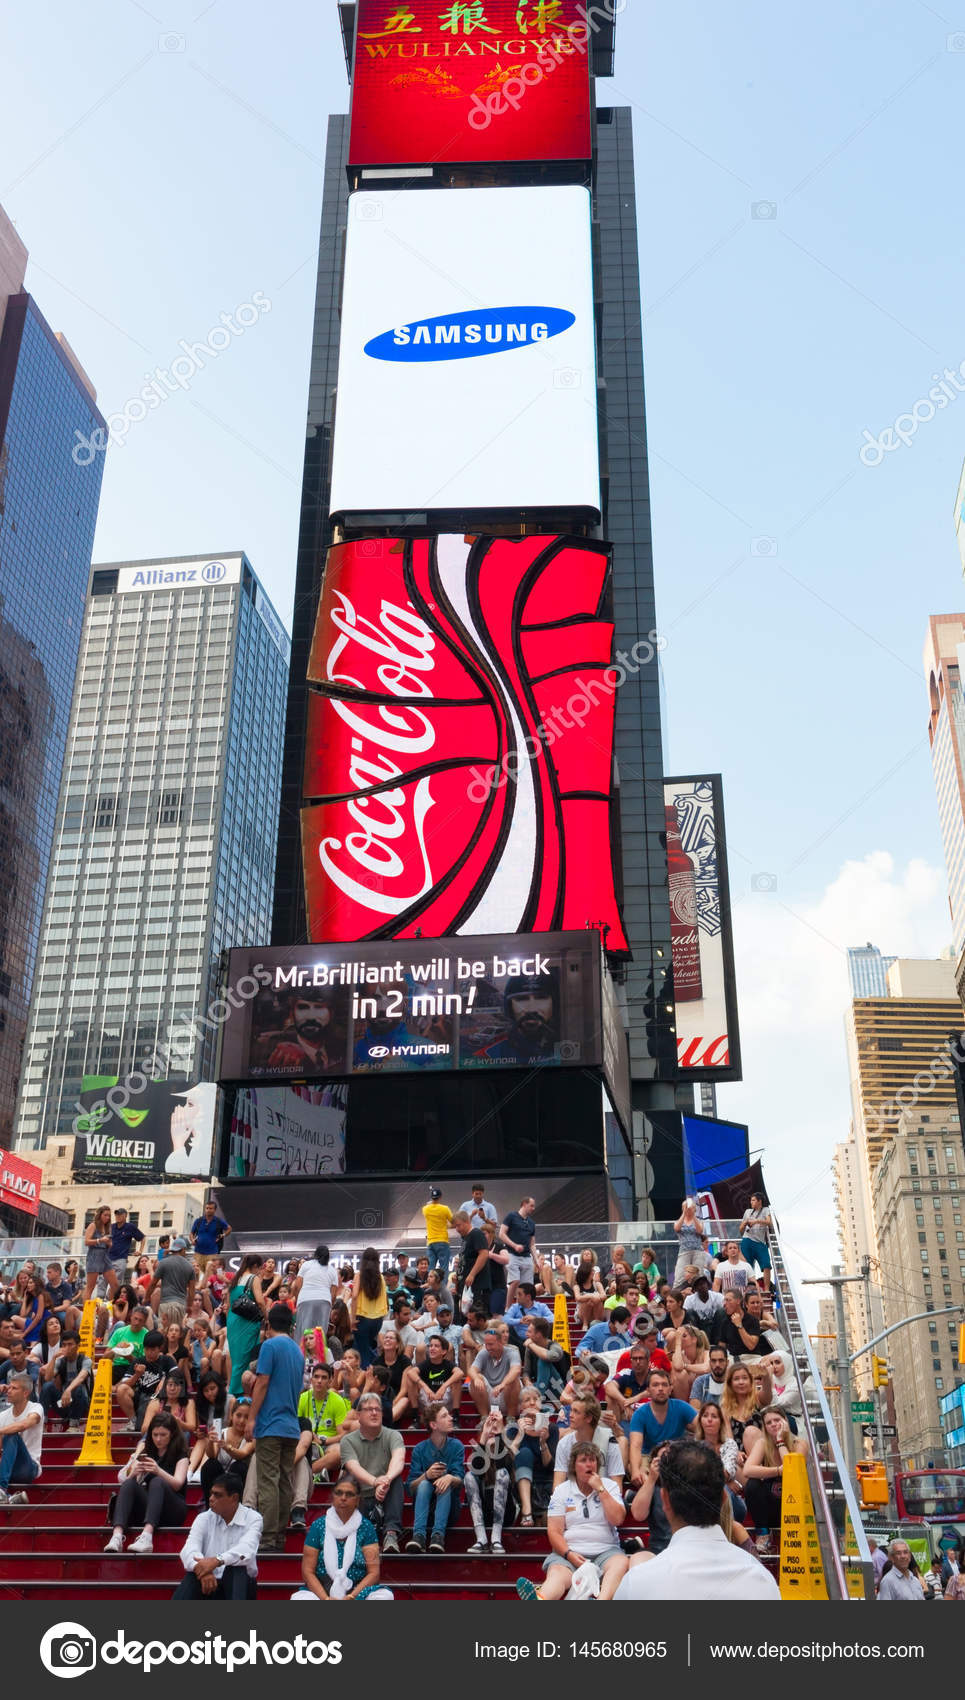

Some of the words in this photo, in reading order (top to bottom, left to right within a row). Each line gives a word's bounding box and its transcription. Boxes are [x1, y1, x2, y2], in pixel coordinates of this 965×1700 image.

[365, 38, 575, 58] WULIANGYE
[393, 322, 549, 345] SAMSUNG
[132, 569, 197, 586] Allianz
[319, 589, 437, 916] Coca-Cola
[275, 961, 404, 988] Mr.Brilliant
[410, 958, 450, 981] will
[457, 957, 486, 979] be
[493, 953, 551, 978] back
[352, 992, 378, 1019] in
[385, 990, 404, 1018] 2
[412, 986, 477, 1016] min!
[391, 1044, 450, 1056] HYUNDAI
[3, 1170, 36, 1197] PLAZA
[782, 1566, 806, 1574] MOJADO
[787, 1556, 800, 1564] PISO
